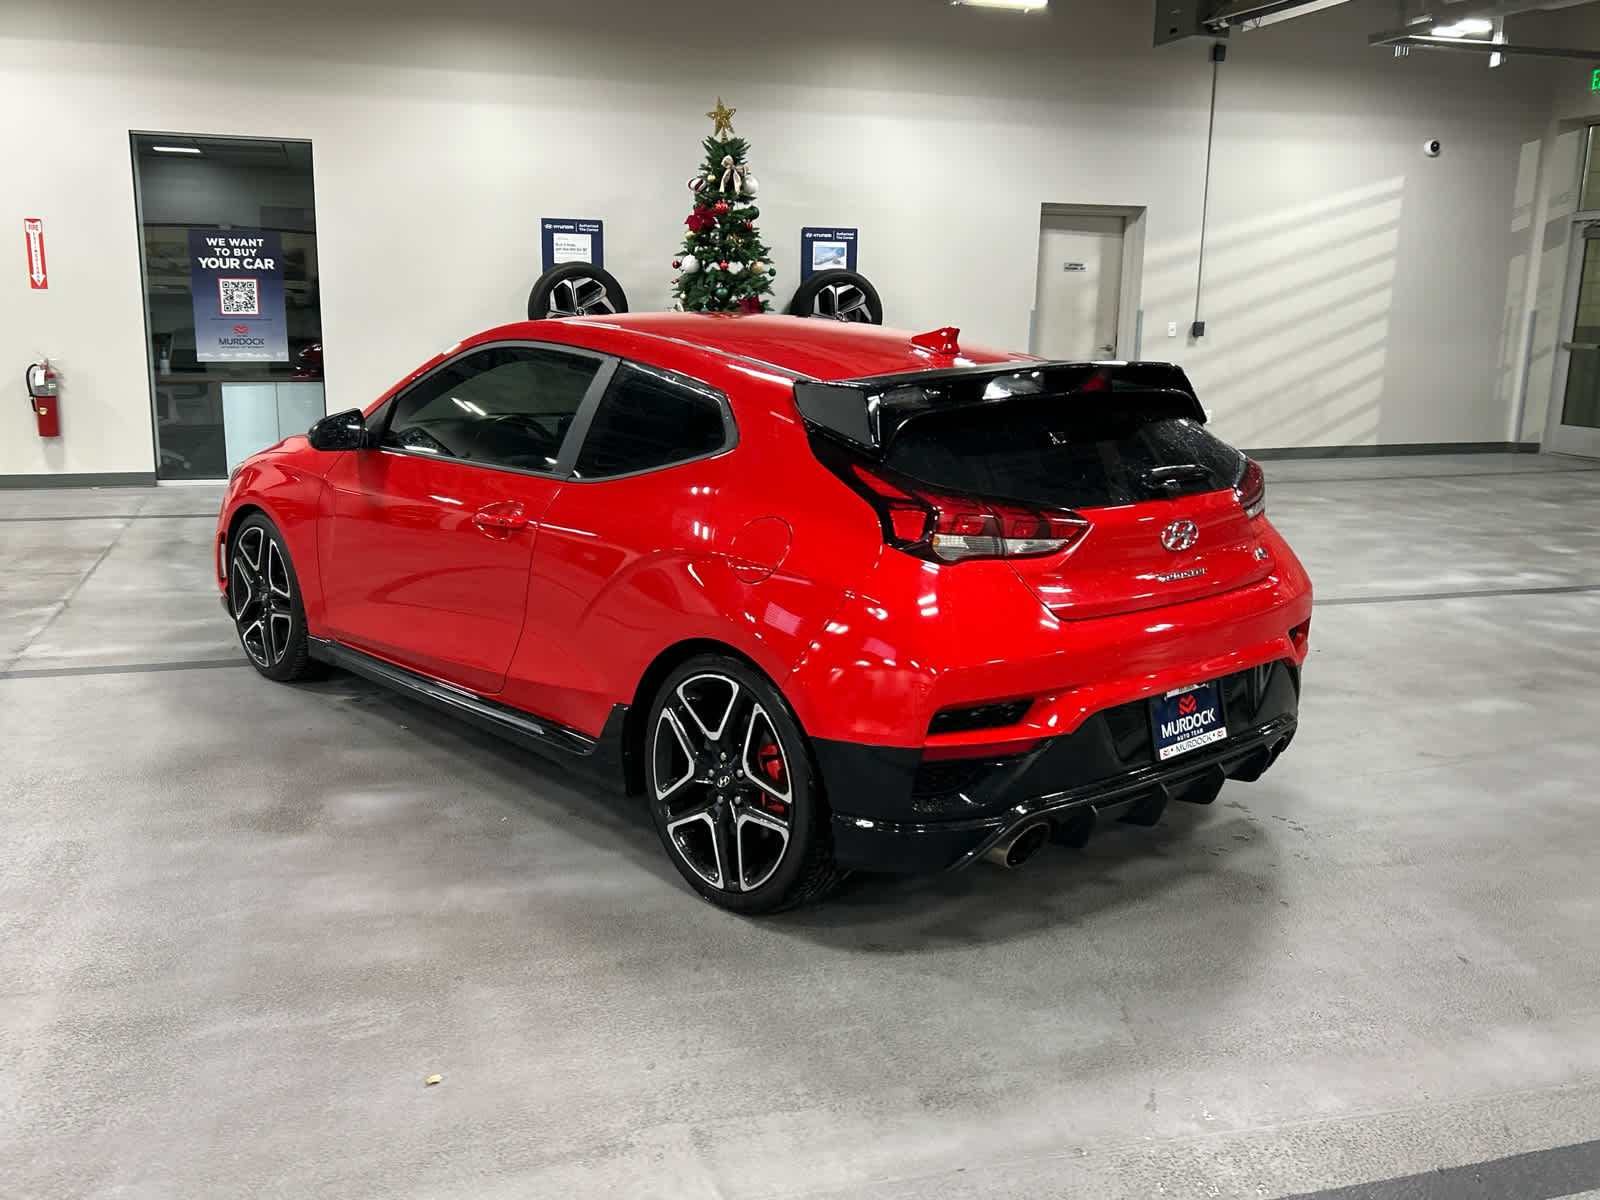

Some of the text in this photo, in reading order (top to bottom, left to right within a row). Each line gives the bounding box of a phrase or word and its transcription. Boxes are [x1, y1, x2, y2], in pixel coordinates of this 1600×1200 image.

[206, 237, 264, 247] WE WANT
[214, 248, 257, 257] TO BUY
[198, 257, 275, 269] YOUR CAR
[219, 337, 264, 345] MURDOCK
[1161, 707, 1216, 739] MURDOCK
[1176, 734, 1213, 753] MURDOCK
